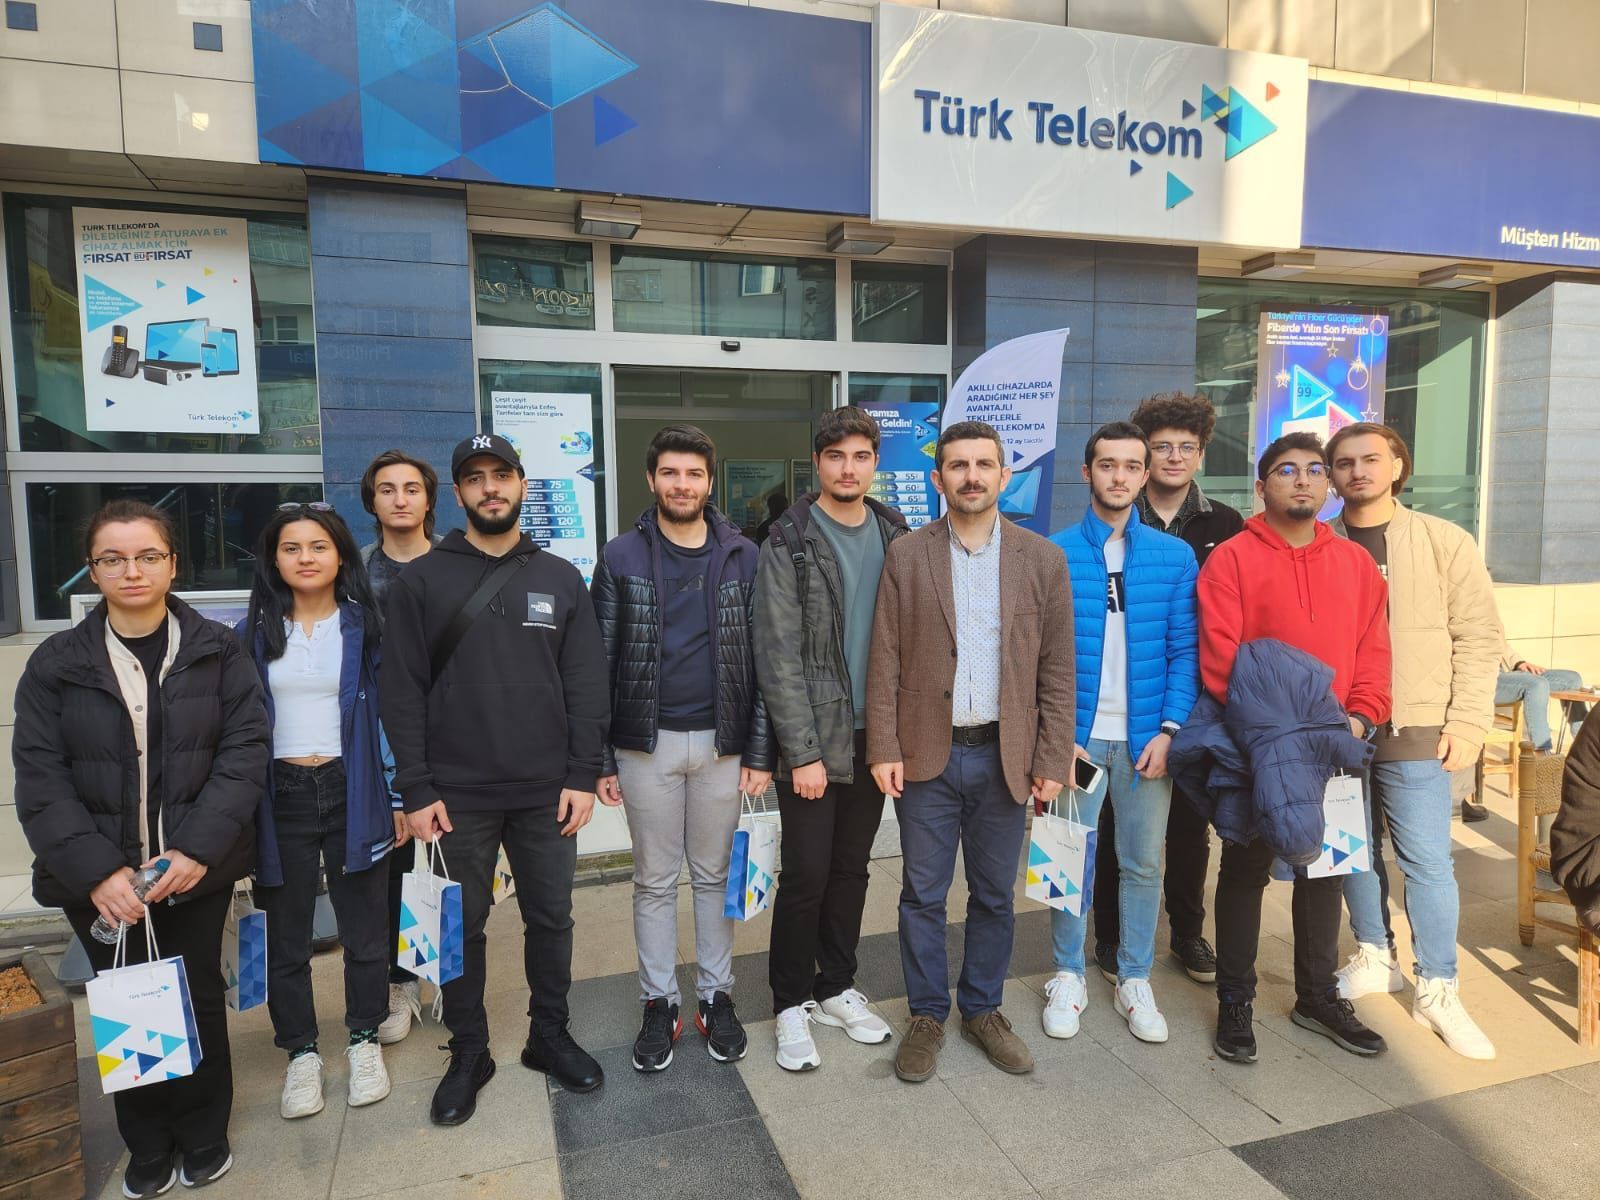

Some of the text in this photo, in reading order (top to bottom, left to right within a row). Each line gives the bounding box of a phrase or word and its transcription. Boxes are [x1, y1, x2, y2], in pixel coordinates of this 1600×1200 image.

[914, 89, 1203, 158] Türk Telekom
[154, 228, 210, 239] FATURAYA
[213, 228, 228, 237] EK
[121, 240, 162, 251] ALMAK
[83, 252, 131, 264] FIRSAT
[146, 250, 192, 262] FIRSAT
[1267, 322, 1300, 333] Fiberde
[1323, 325, 1340, 334] Son
[967, 383, 994, 392] AKILLI
[1297, 386, 1312, 397] 99
[1019, 392, 1038, 400] HER
[1040, 391, 1055, 400] ŞEY
[966, 404, 1012, 412] AVANTAJLI
[208, 414, 239, 422] Telekom
[881, 418, 913, 428] Geldin!
[550, 480, 562, 489] 75
[552, 493, 565, 501] 85
[553, 505, 571, 513] 100
[557, 517, 574, 525] 120
[560, 529, 577, 538] 135
